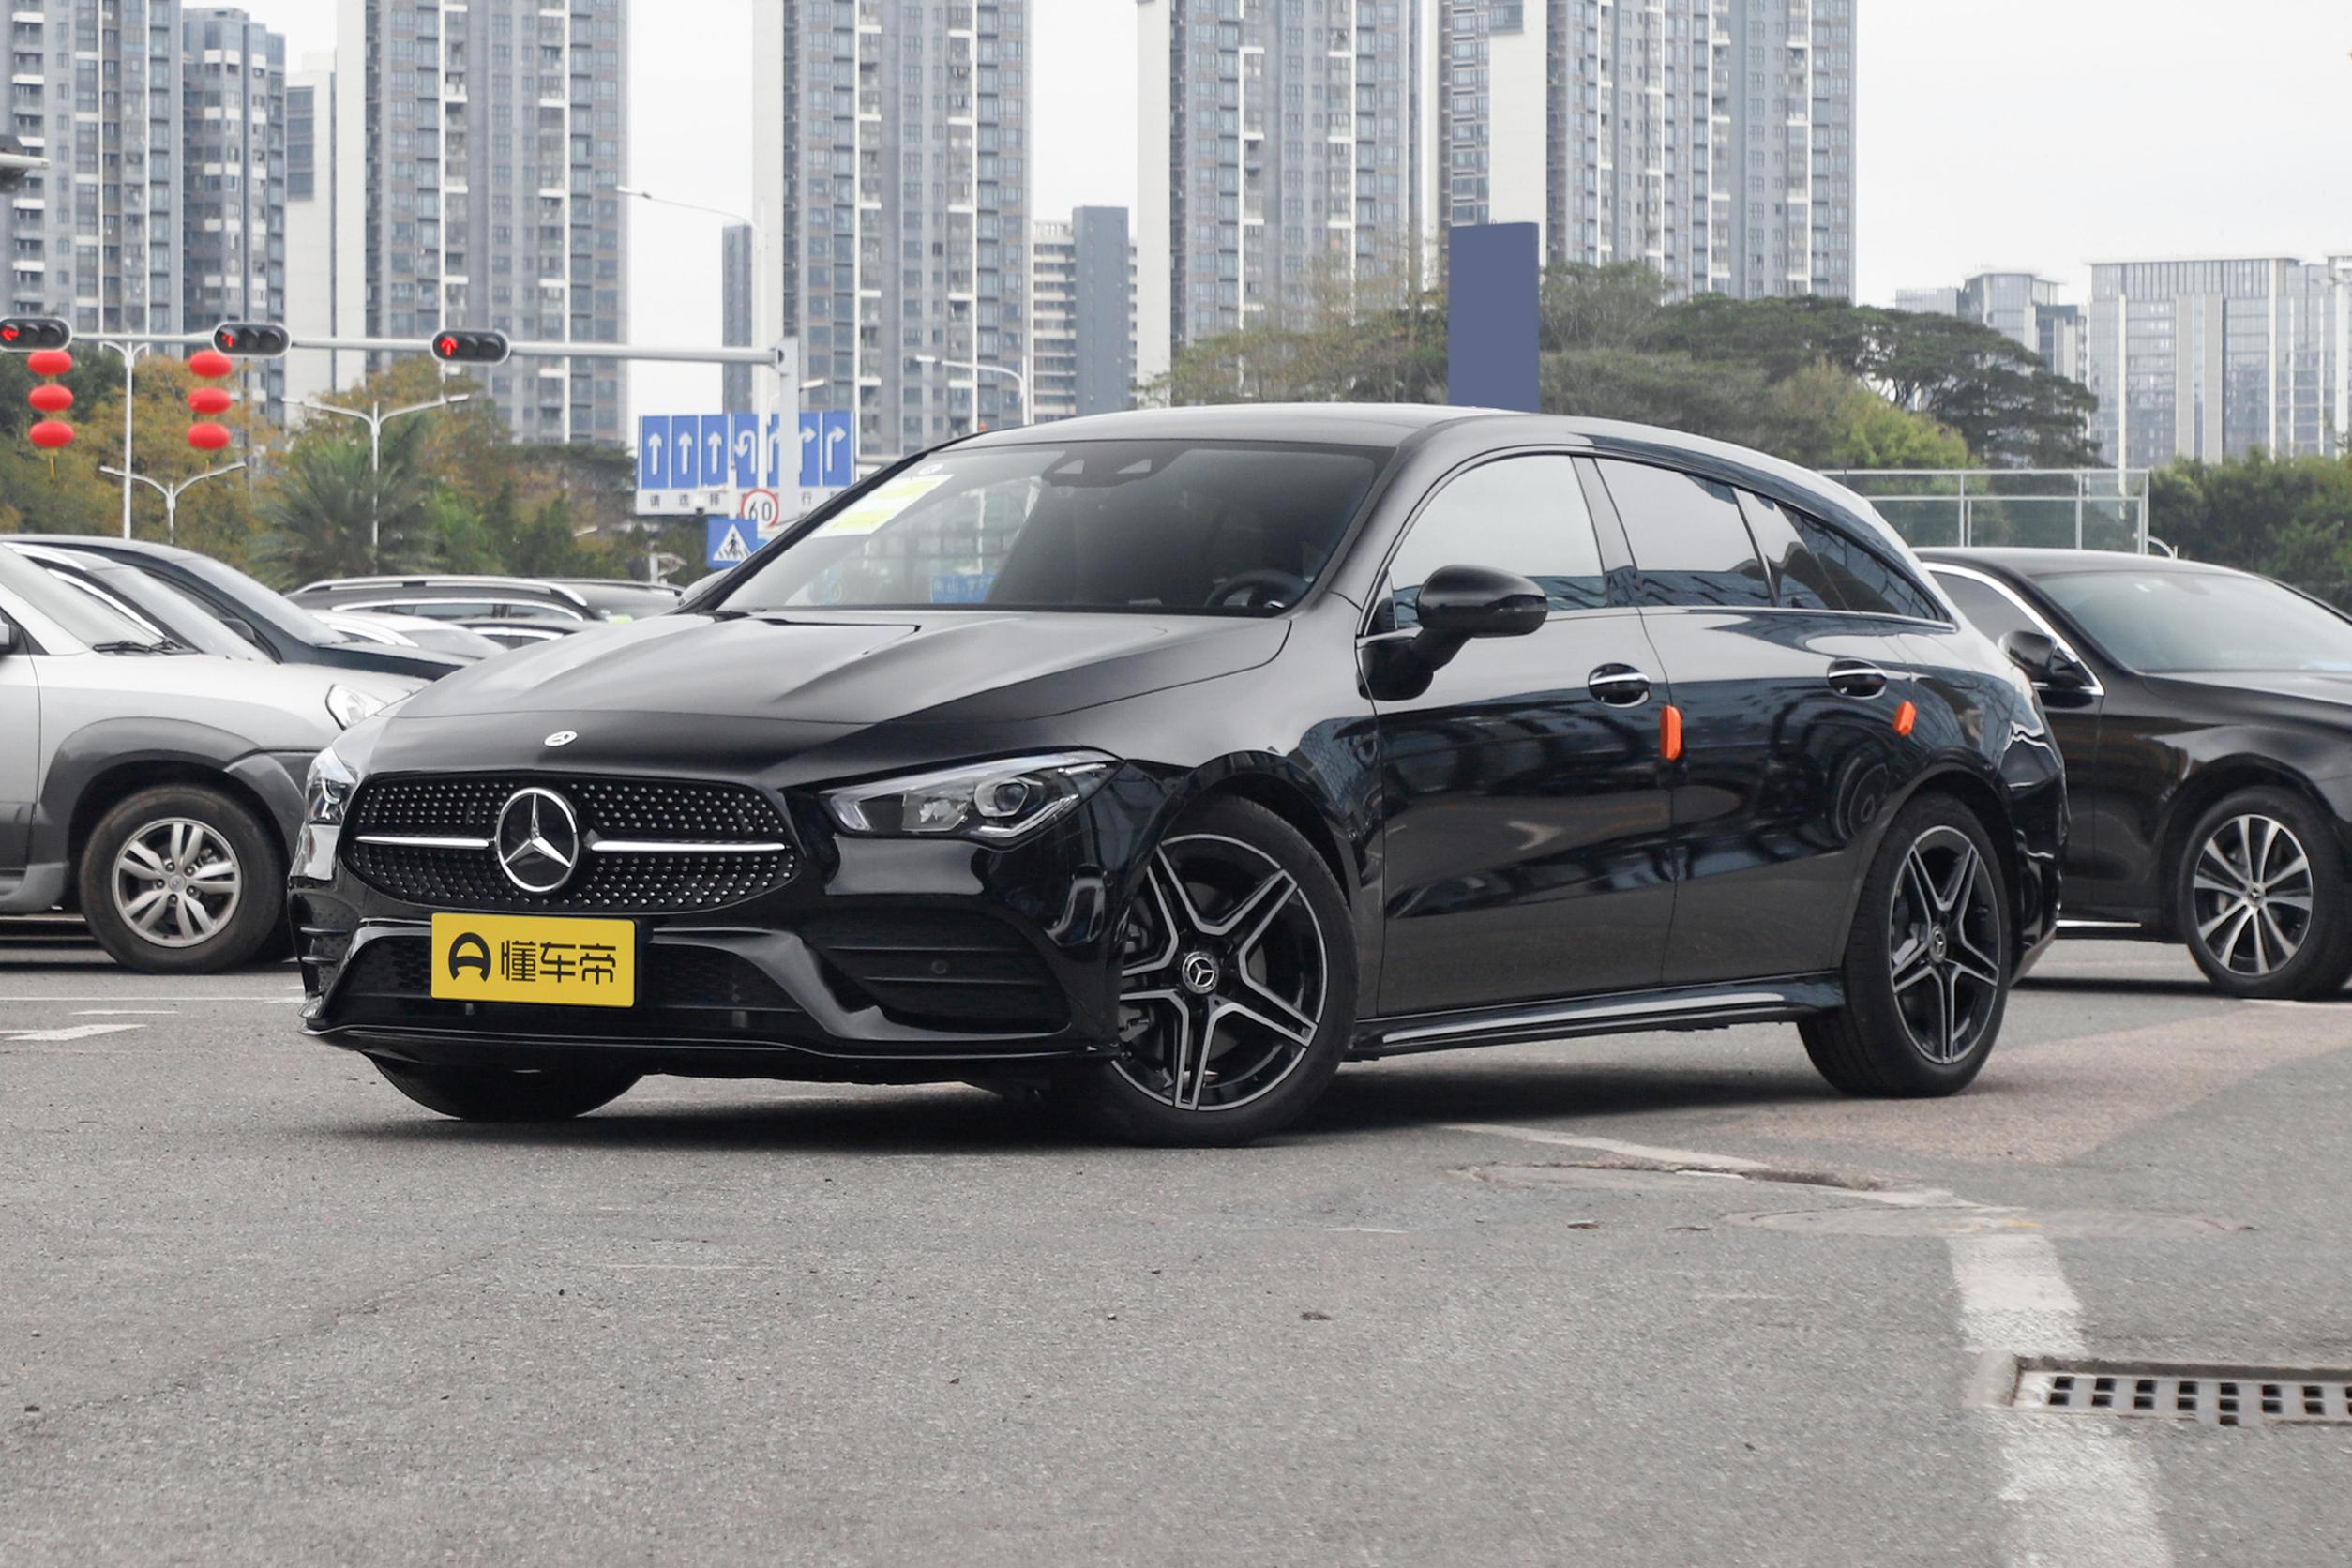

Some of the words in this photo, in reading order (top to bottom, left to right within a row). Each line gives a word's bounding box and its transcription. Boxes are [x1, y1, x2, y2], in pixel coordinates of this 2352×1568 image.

[748, 501, 773, 521] 60
[501, 940, 617, 985] 懂车帝
